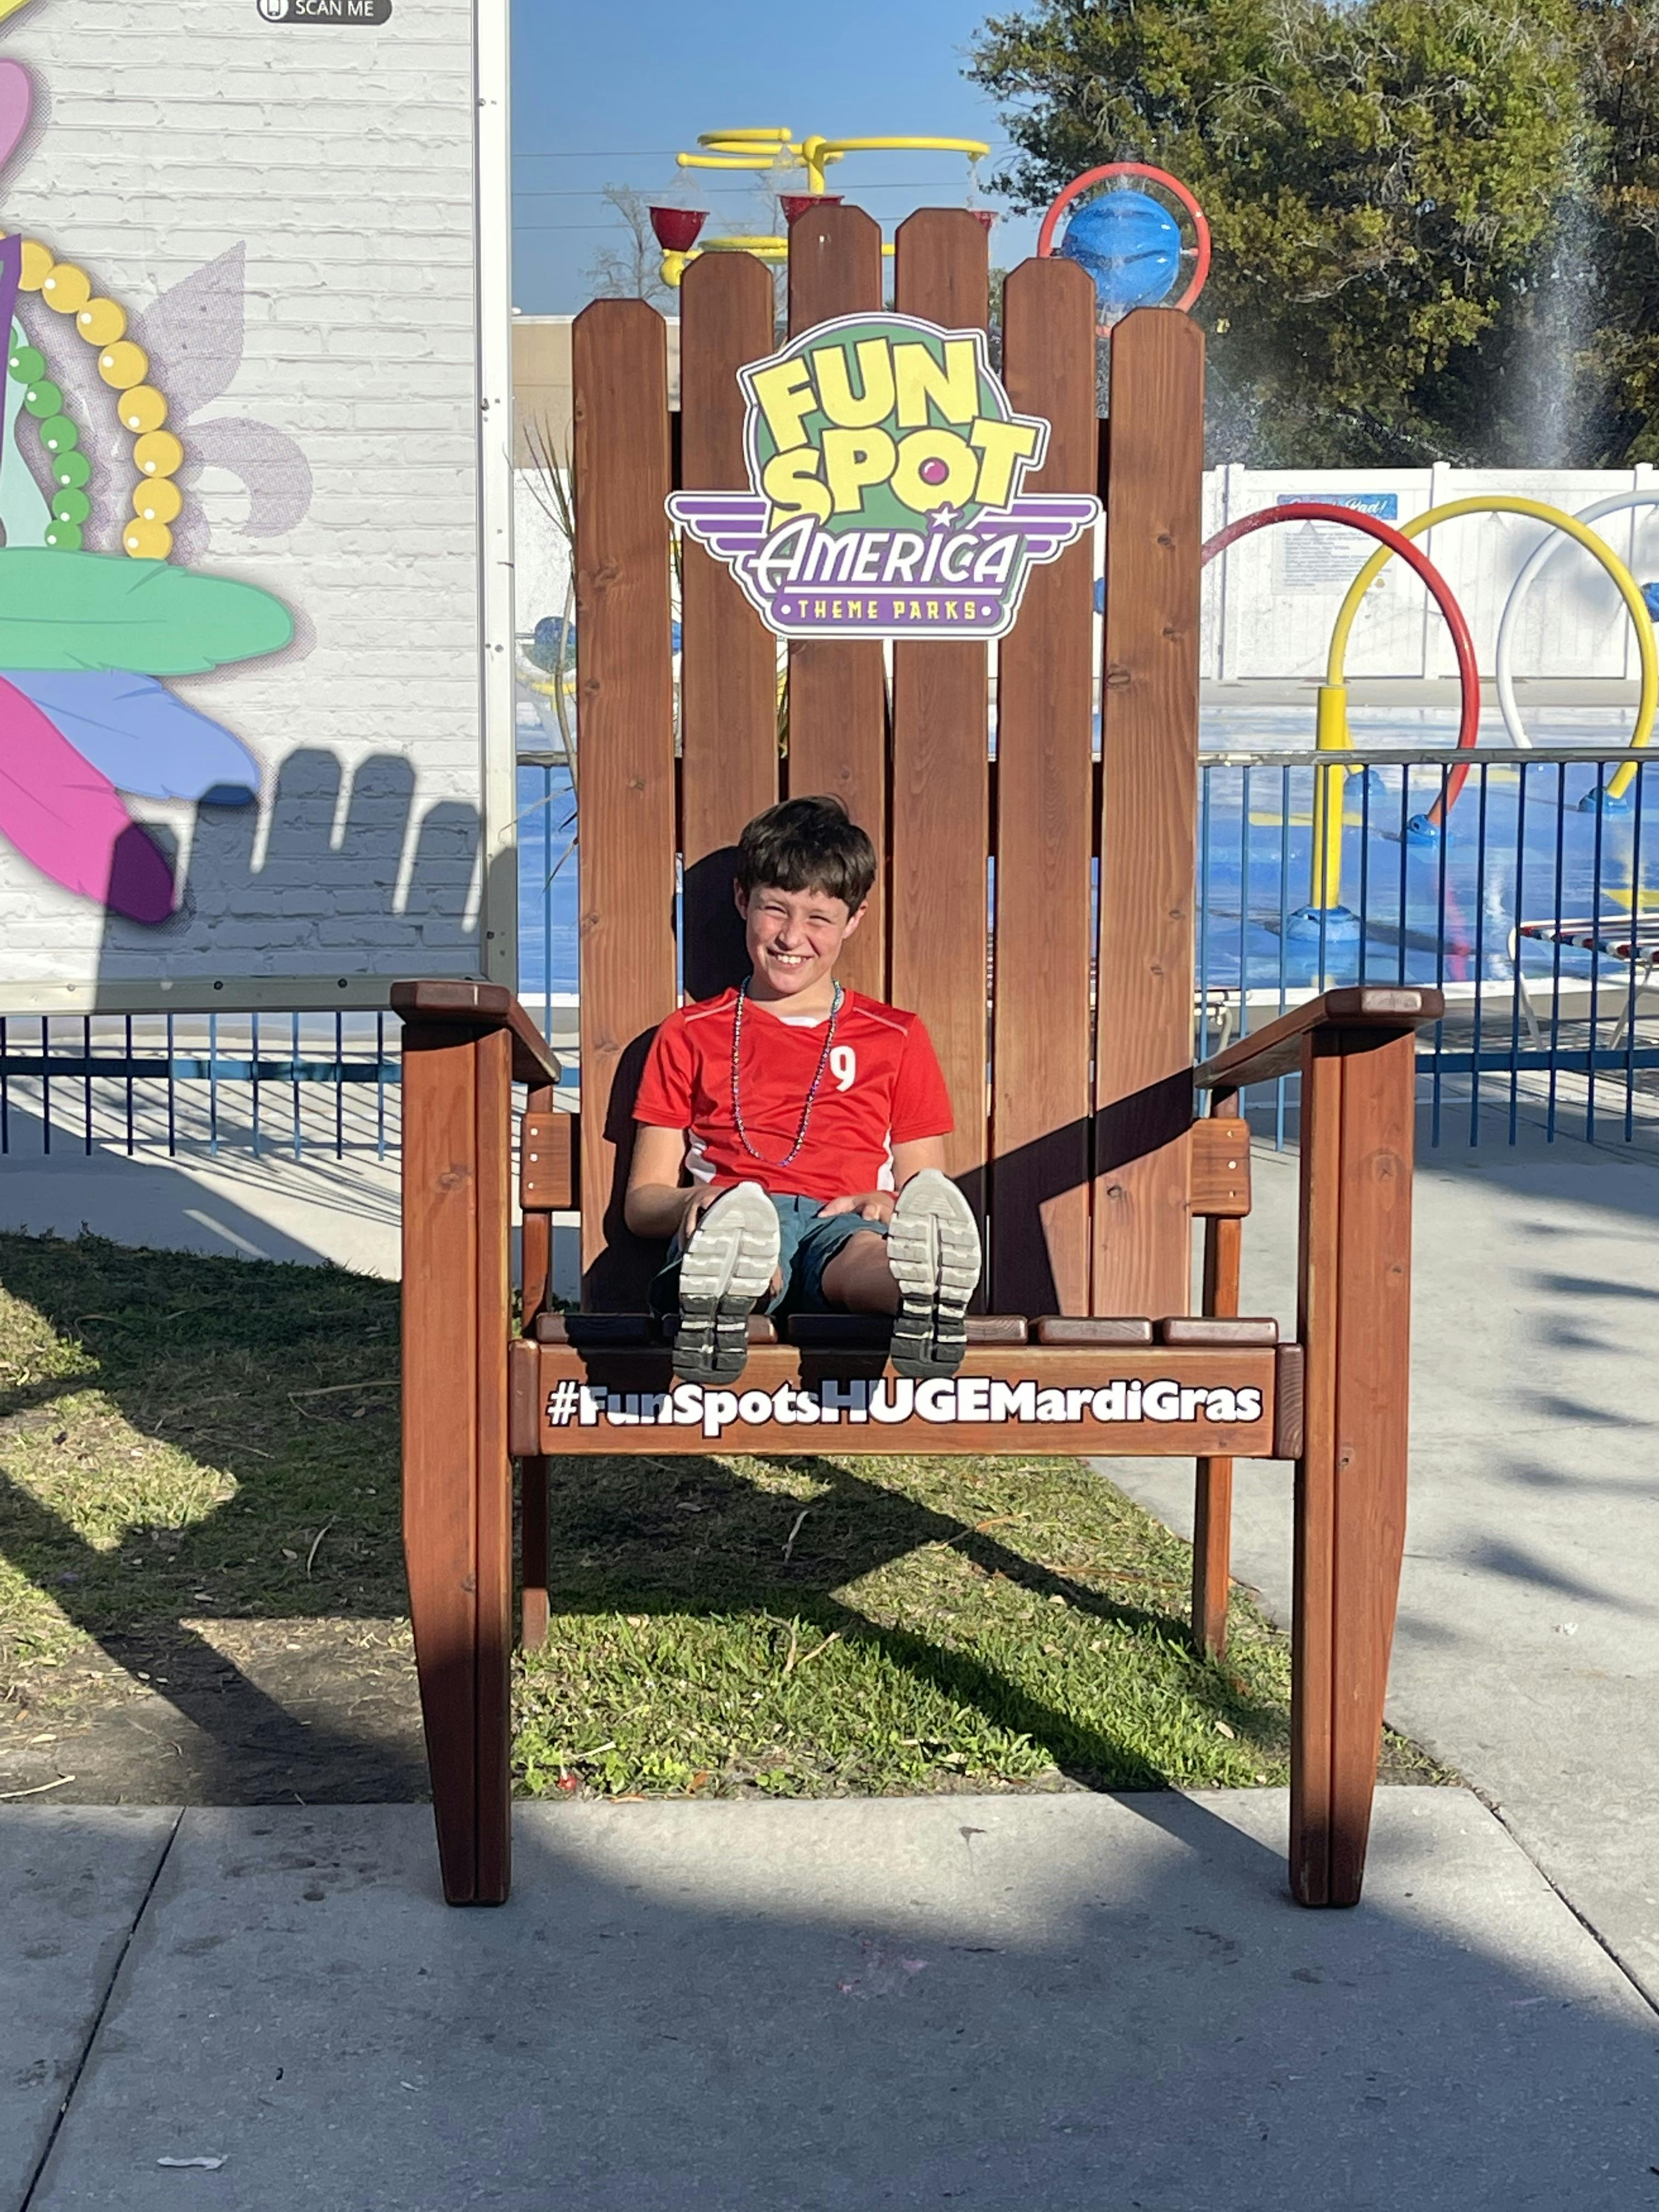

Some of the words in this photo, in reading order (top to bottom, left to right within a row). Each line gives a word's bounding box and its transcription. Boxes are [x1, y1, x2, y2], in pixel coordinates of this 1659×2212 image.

[296, 0, 342, 16] SCAN
[348, 1, 374, 16] ME
[749, 335, 979, 453] FUN
[761, 416, 1040, 532] SPOT
[747, 517, 1019, 592] AMERICA
[799, 600, 878, 619] THEME
[894, 600, 977, 619] PARKS
[830, 1045, 856, 1092] 9
[546, 1376, 1263, 1438] #FunSpotsHUGEMardiGras
